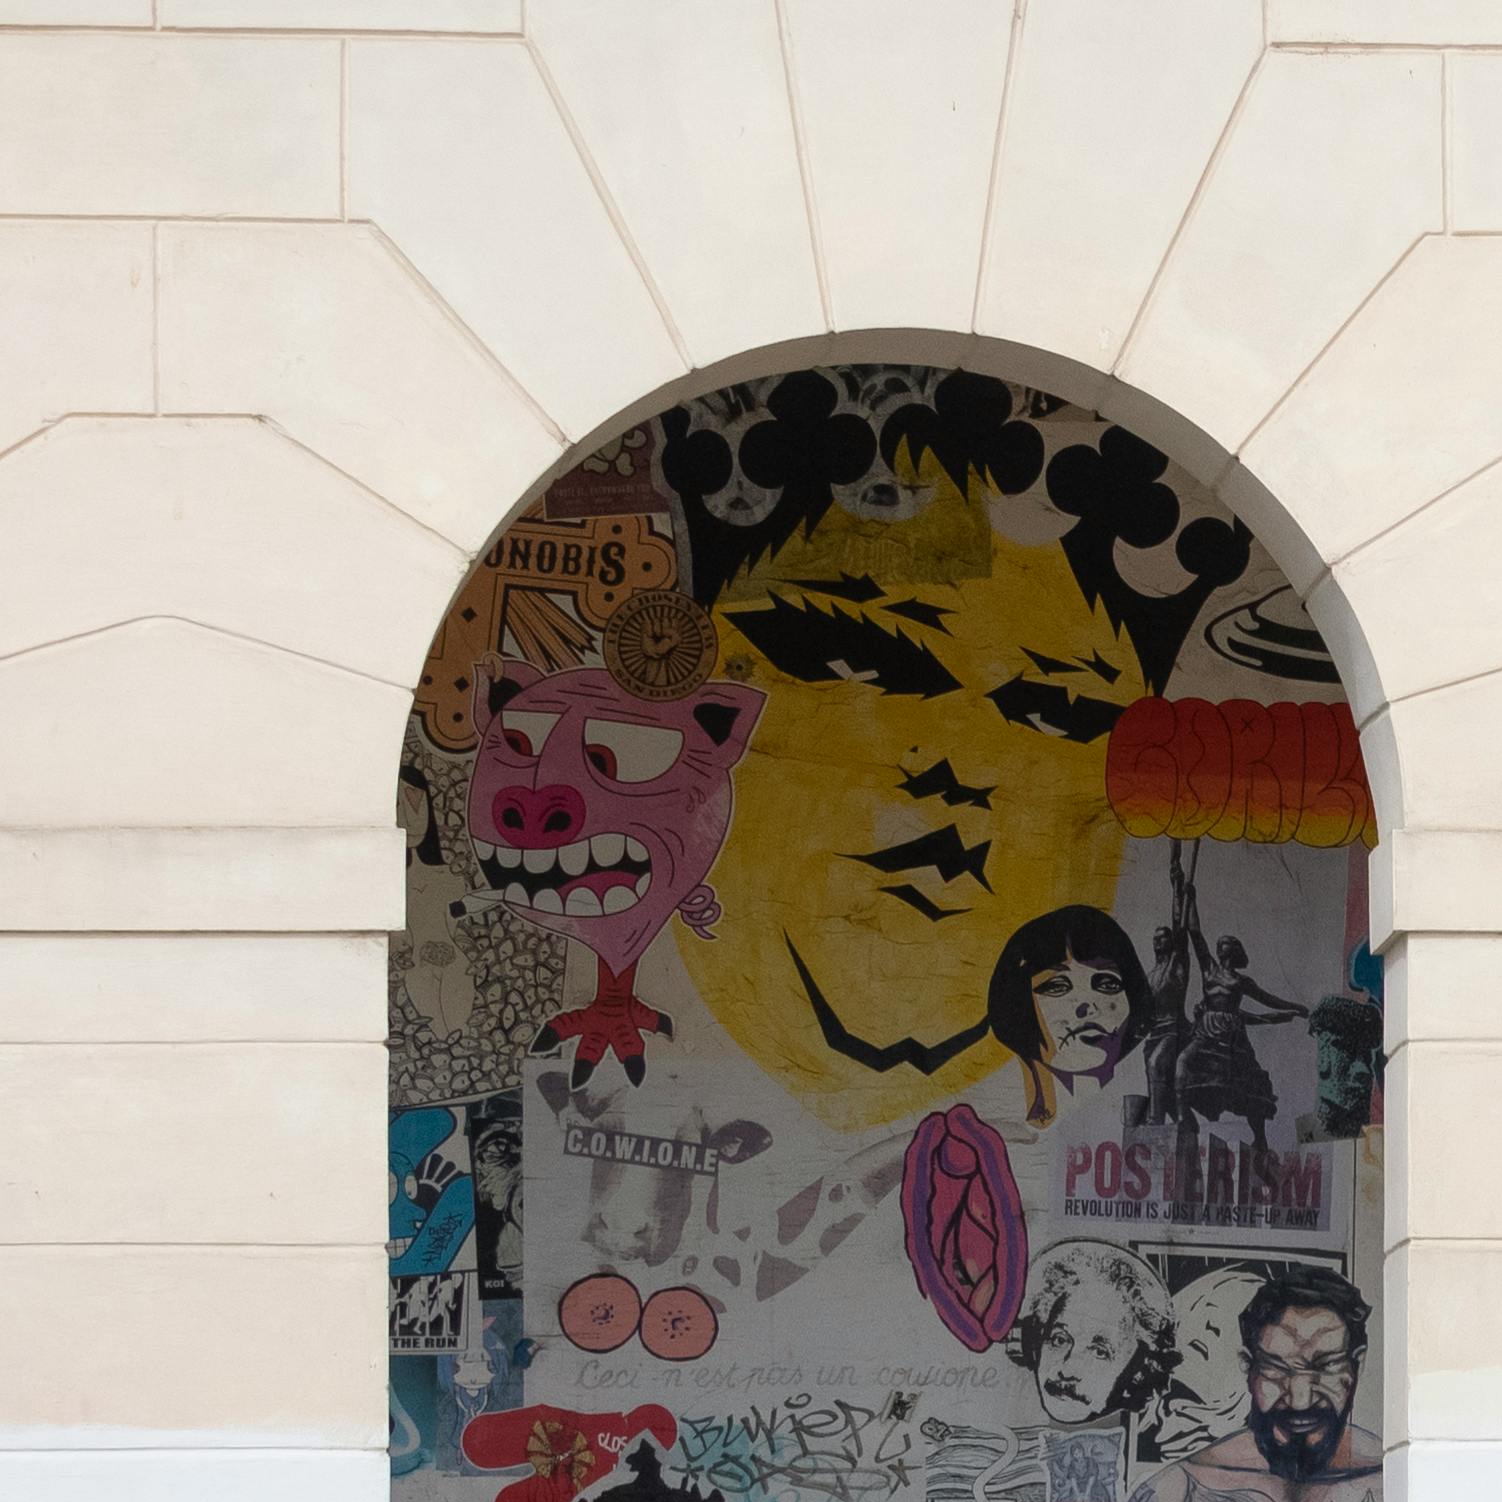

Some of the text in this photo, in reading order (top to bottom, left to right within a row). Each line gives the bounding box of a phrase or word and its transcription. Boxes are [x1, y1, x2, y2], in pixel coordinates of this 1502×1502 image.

[1064, 1140, 1323, 1209] POSTERISM
[1064, 1199, 1321, 1226] REVOLUTION IS JUST A PASTE-UP AWAY
[392, 1337, 458, 1348] THE RUN
[574, 1359, 641, 1390] Ceci
[742, 1365, 803, 1394] pas
[816, 1364, 857, 1387] un
